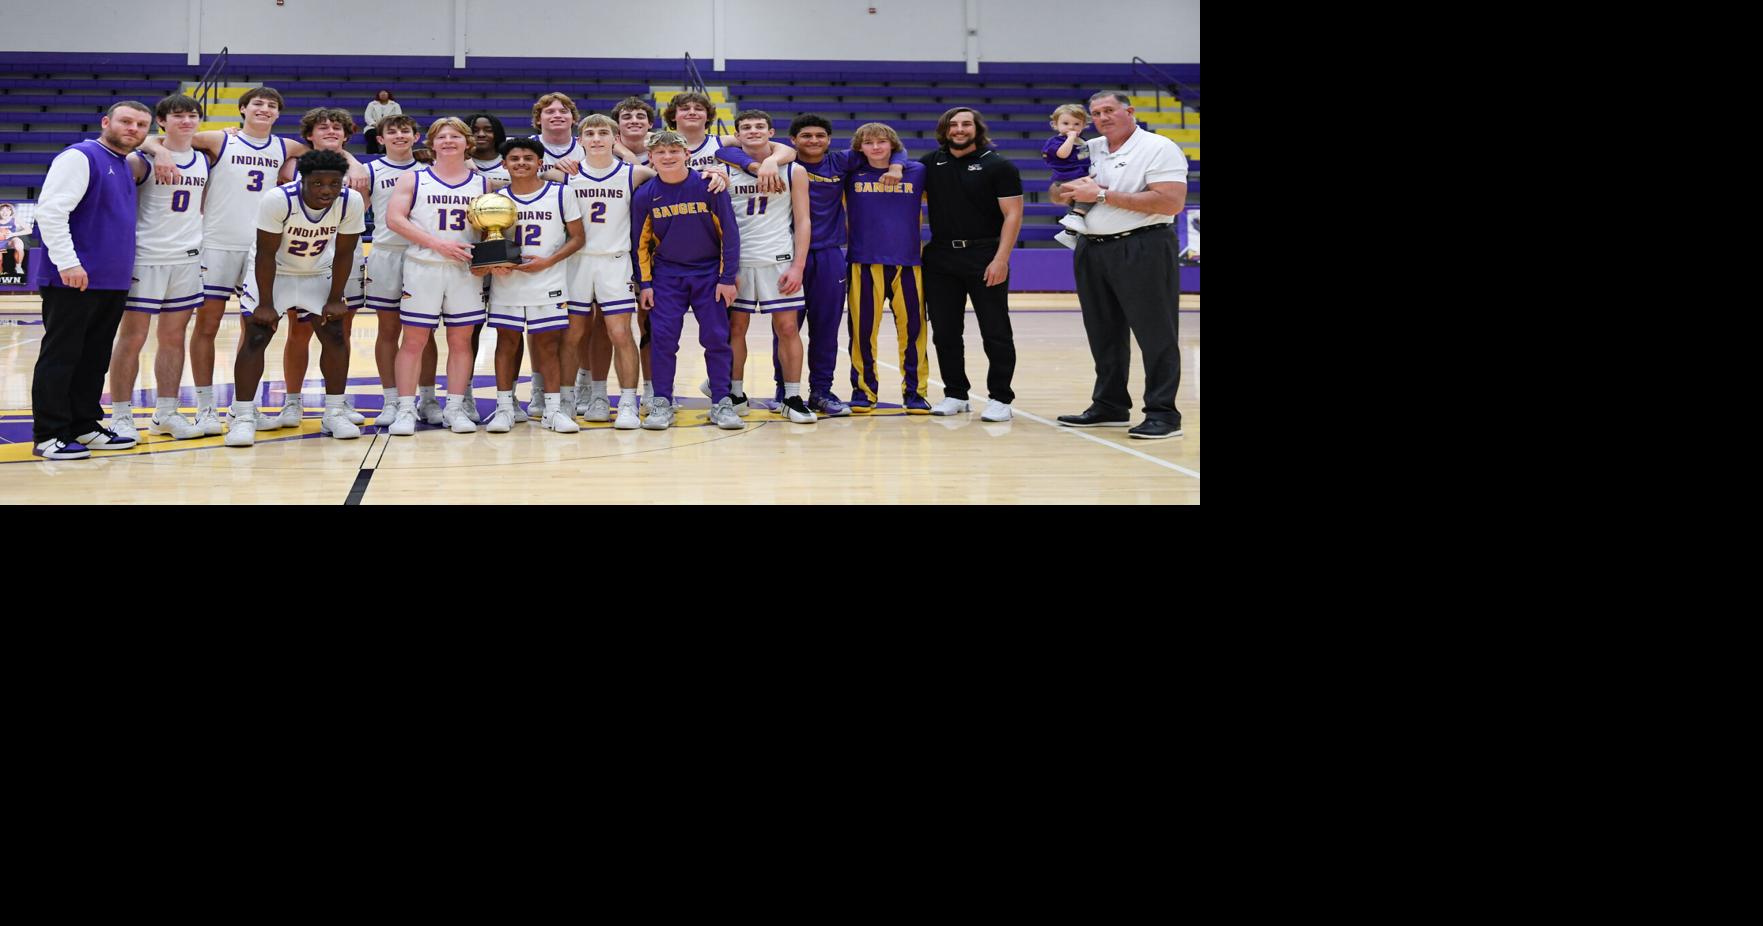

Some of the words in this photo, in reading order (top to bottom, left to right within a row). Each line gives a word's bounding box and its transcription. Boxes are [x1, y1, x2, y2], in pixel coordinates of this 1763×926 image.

[231, 155, 279, 169] INDIANS
[246, 170, 264, 192] 3
[171, 190, 190, 212] 0
[427, 195, 474, 205] INDIAN
[575, 189, 623, 199] INDIANS
[590, 202, 607, 223] 2
[747, 196, 768, 215] 11
[437, 208, 466, 231] 13
[287, 226, 336, 237] INDIANS
[514, 224, 541, 246] 12
[287, 239, 328, 256] 23
